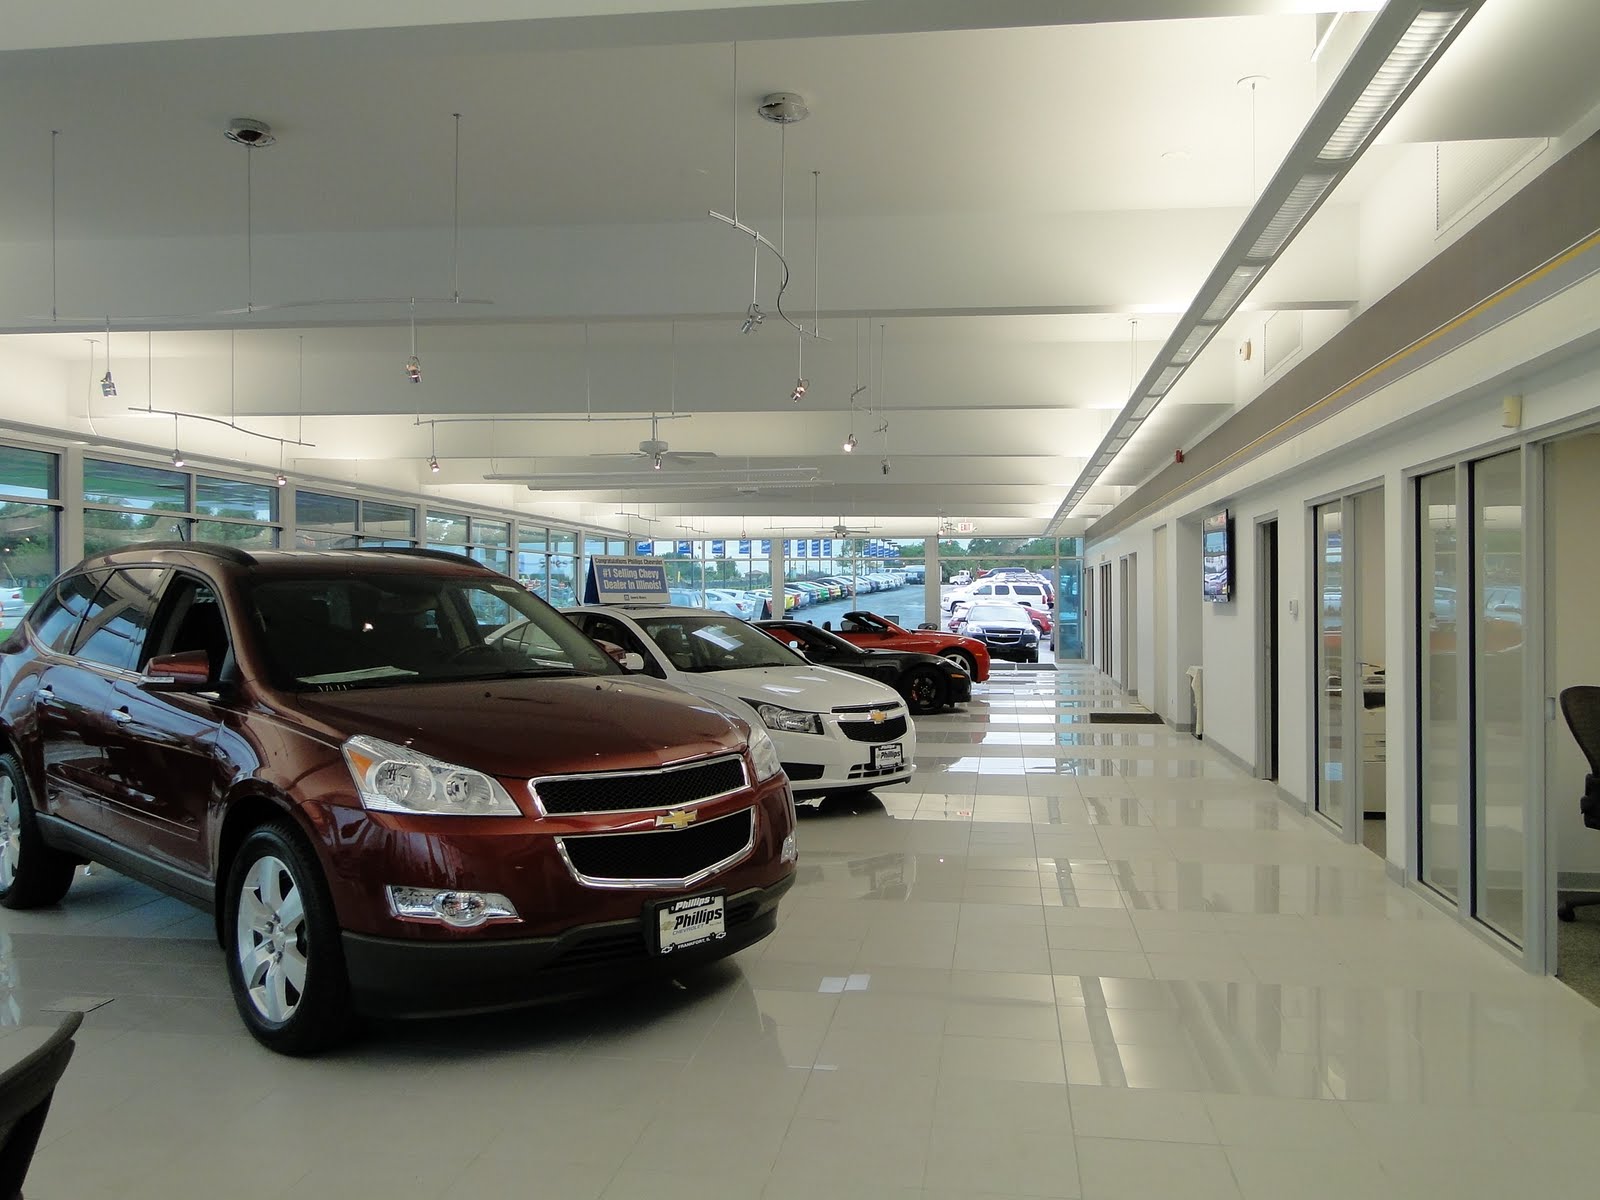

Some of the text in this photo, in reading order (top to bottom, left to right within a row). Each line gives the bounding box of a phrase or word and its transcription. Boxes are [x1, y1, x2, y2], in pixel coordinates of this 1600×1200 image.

[602, 568, 659, 579] #1 Selling Chevy
[604, 580, 626, 589] Dealer
[636, 580, 662, 589] Illinois!
[675, 897, 710, 911] Phillips
[674, 908, 722, 930] Phillips
